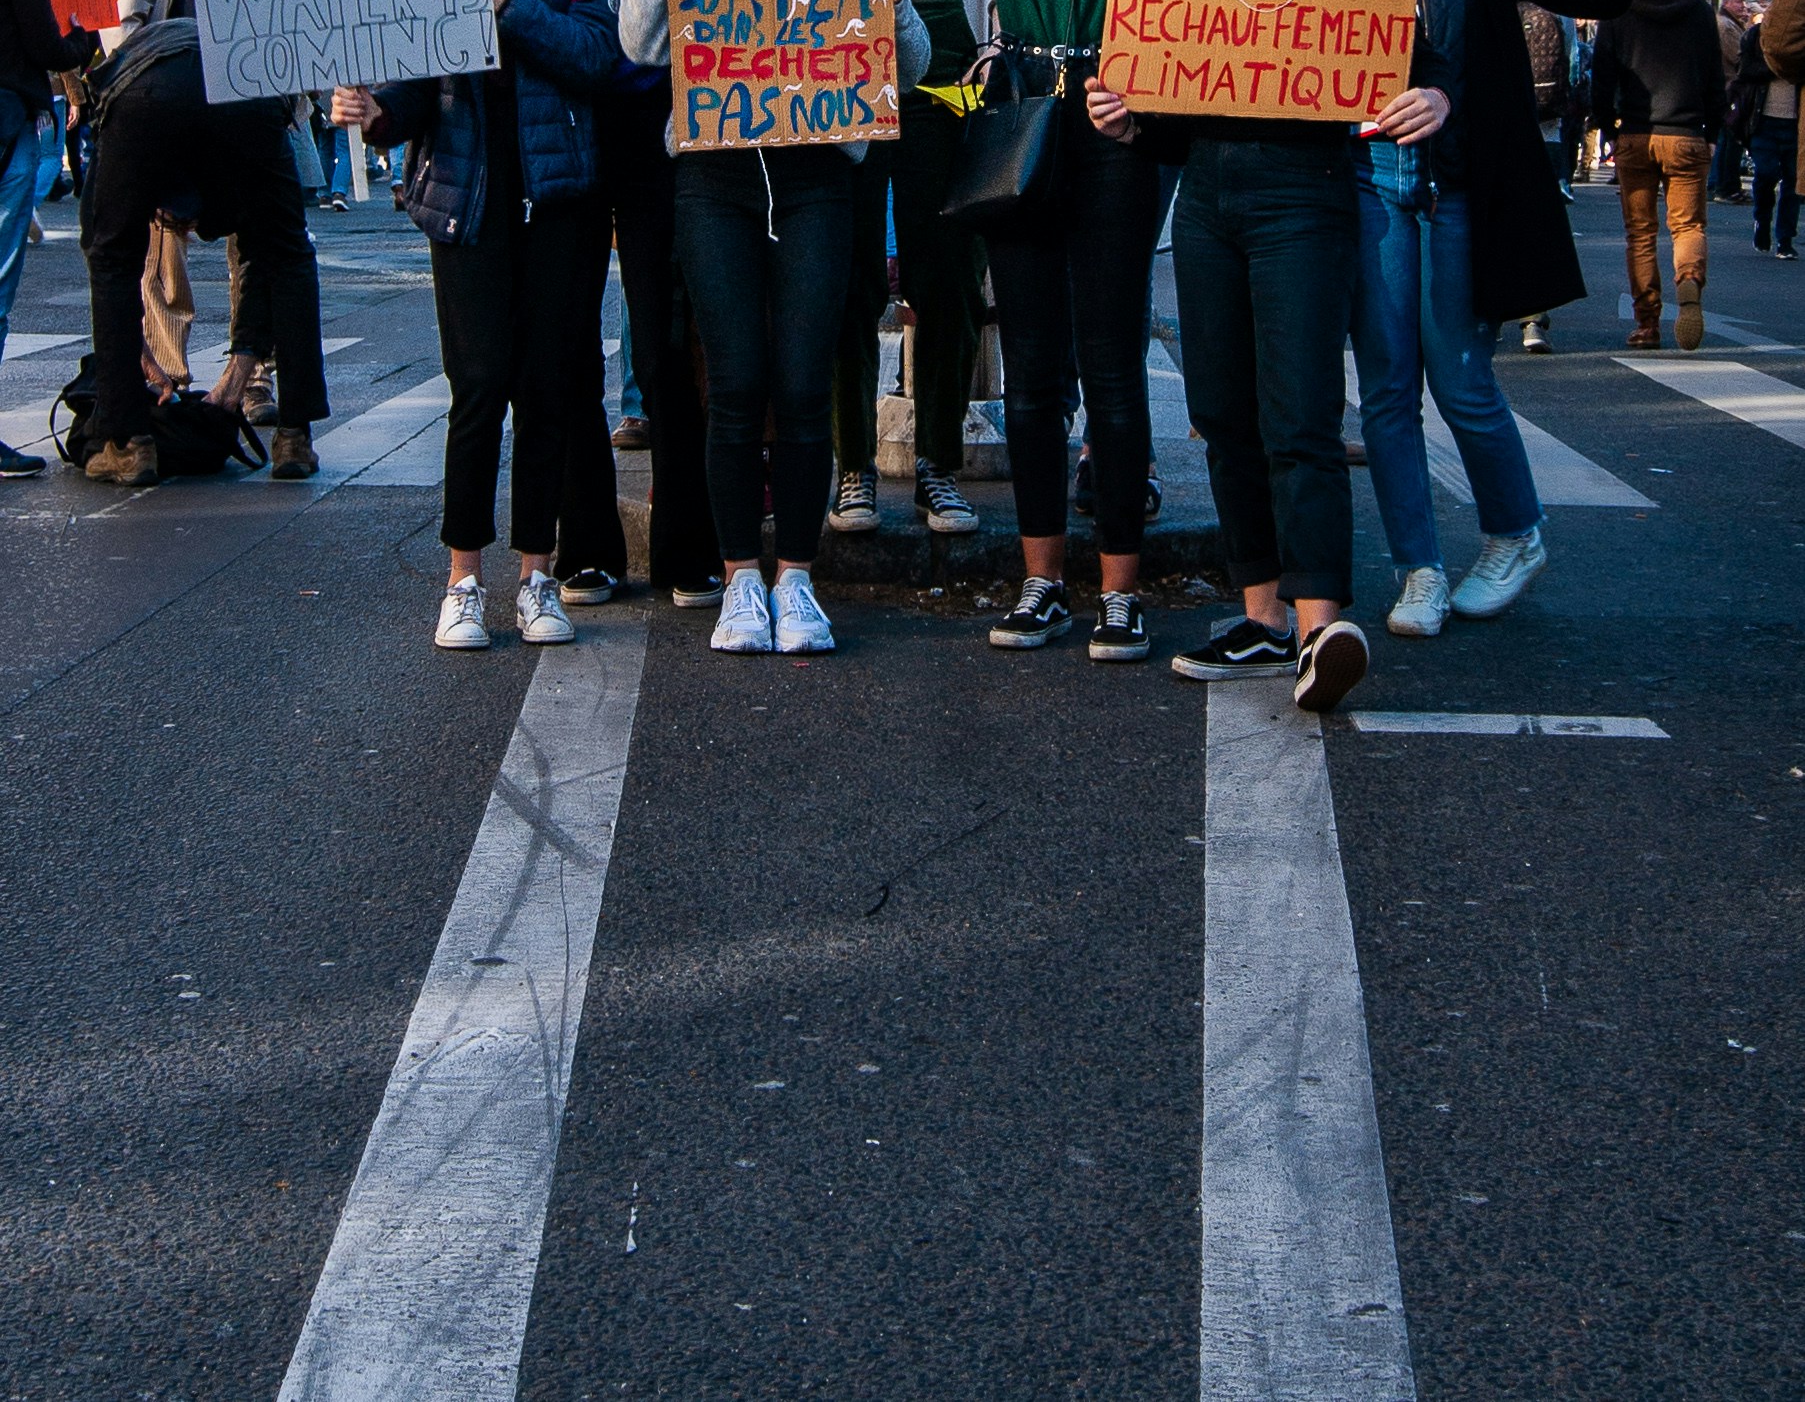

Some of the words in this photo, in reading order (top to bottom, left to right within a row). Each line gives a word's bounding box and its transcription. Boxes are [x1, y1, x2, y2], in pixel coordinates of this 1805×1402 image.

[693, 10, 766, 47] DANS
[774, 17, 830, 48] LES
[686, 81, 782, 140] PAS
